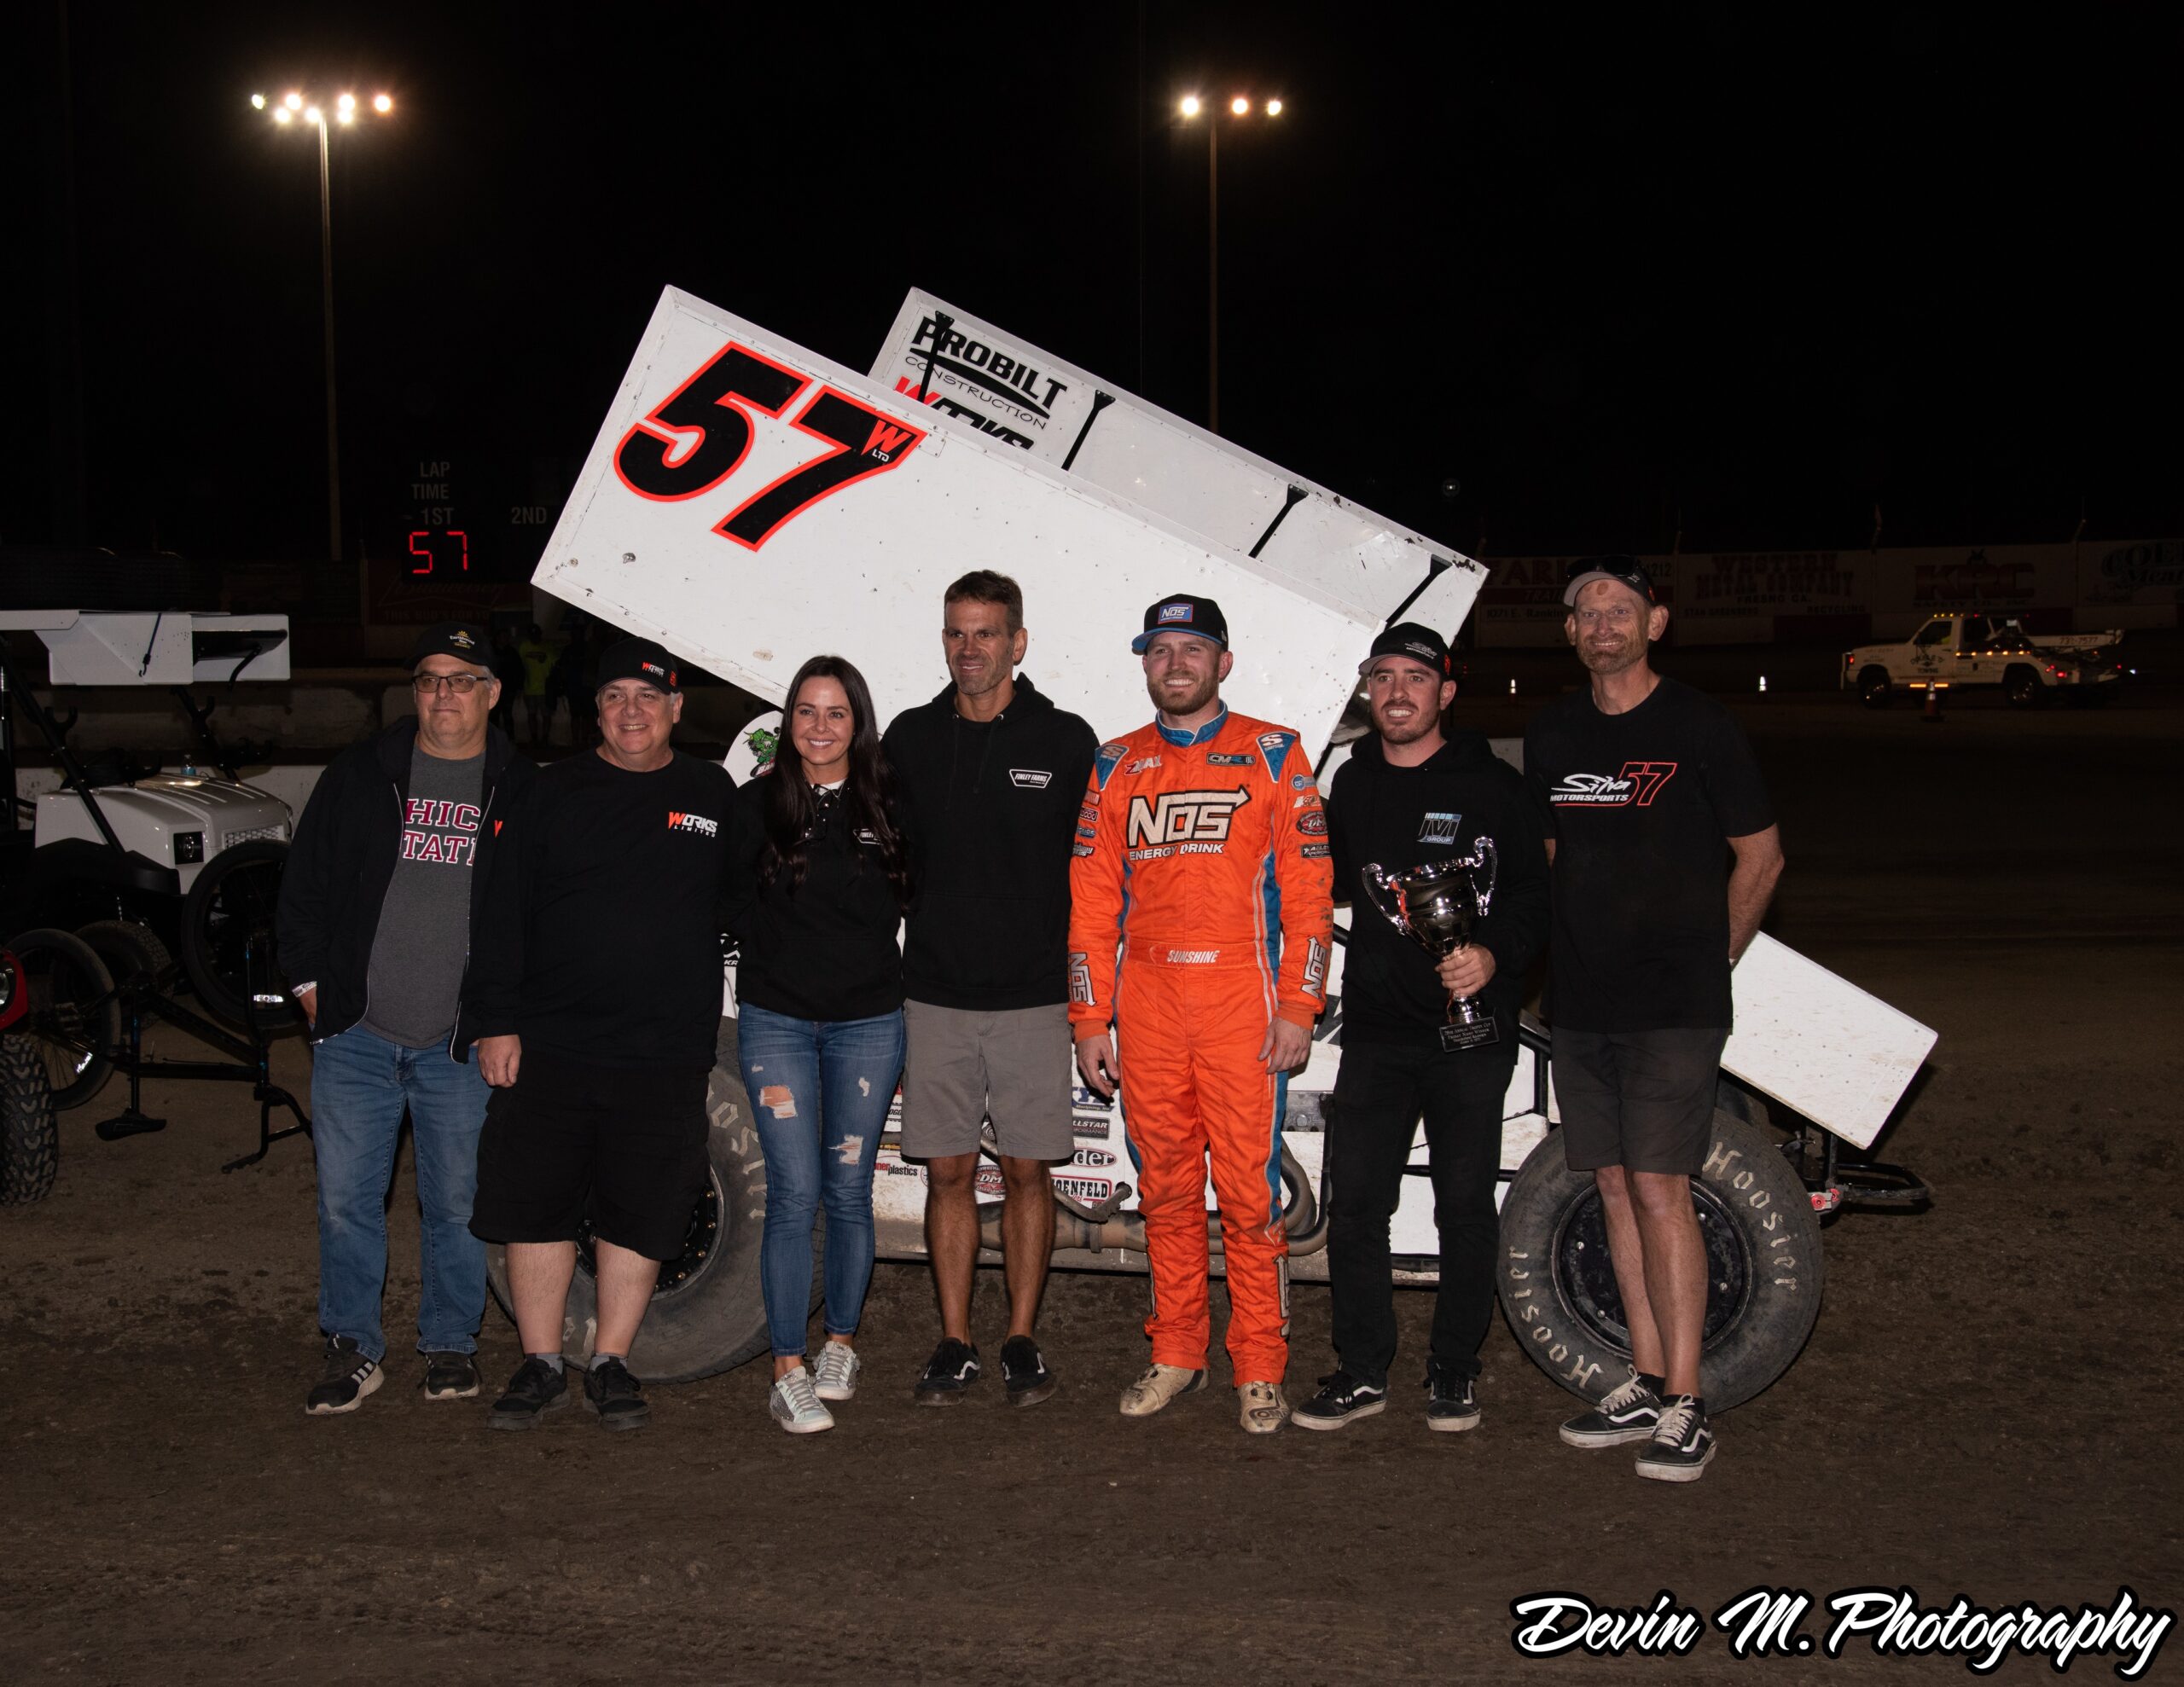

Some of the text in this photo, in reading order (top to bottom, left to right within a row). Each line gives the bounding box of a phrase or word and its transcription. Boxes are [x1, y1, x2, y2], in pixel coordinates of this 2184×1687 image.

[911, 316, 1068, 410] PROBILT
[905, 356, 1047, 431] CONSTRUCTION
[613, 340, 929, 553] 57
[871, 449, 890, 462] LTD
[420, 461, 450, 478] LAP
[411, 484, 450, 500] TIME
[511, 507, 548, 525] 2ND
[409, 531, 468, 574] 57
[1737, 594, 1786, 604] FRESNO
[385, 610, 410, 621] THIS
[1161, 606, 1189, 618] NOS
[1807, 604, 1866, 613] RECYCLING
[1618, 762, 1678, 806] 57
[1549, 794, 1629, 803] MOTORSPORTS
[668, 812, 718, 833] WORKS
[1127, 786, 1251, 849] NOS
[674, 825, 716, 838] LIMITED
[1129, 843, 1224, 861] ENERGY DRINK
[1167, 950, 1221, 964] SUNSHINE
